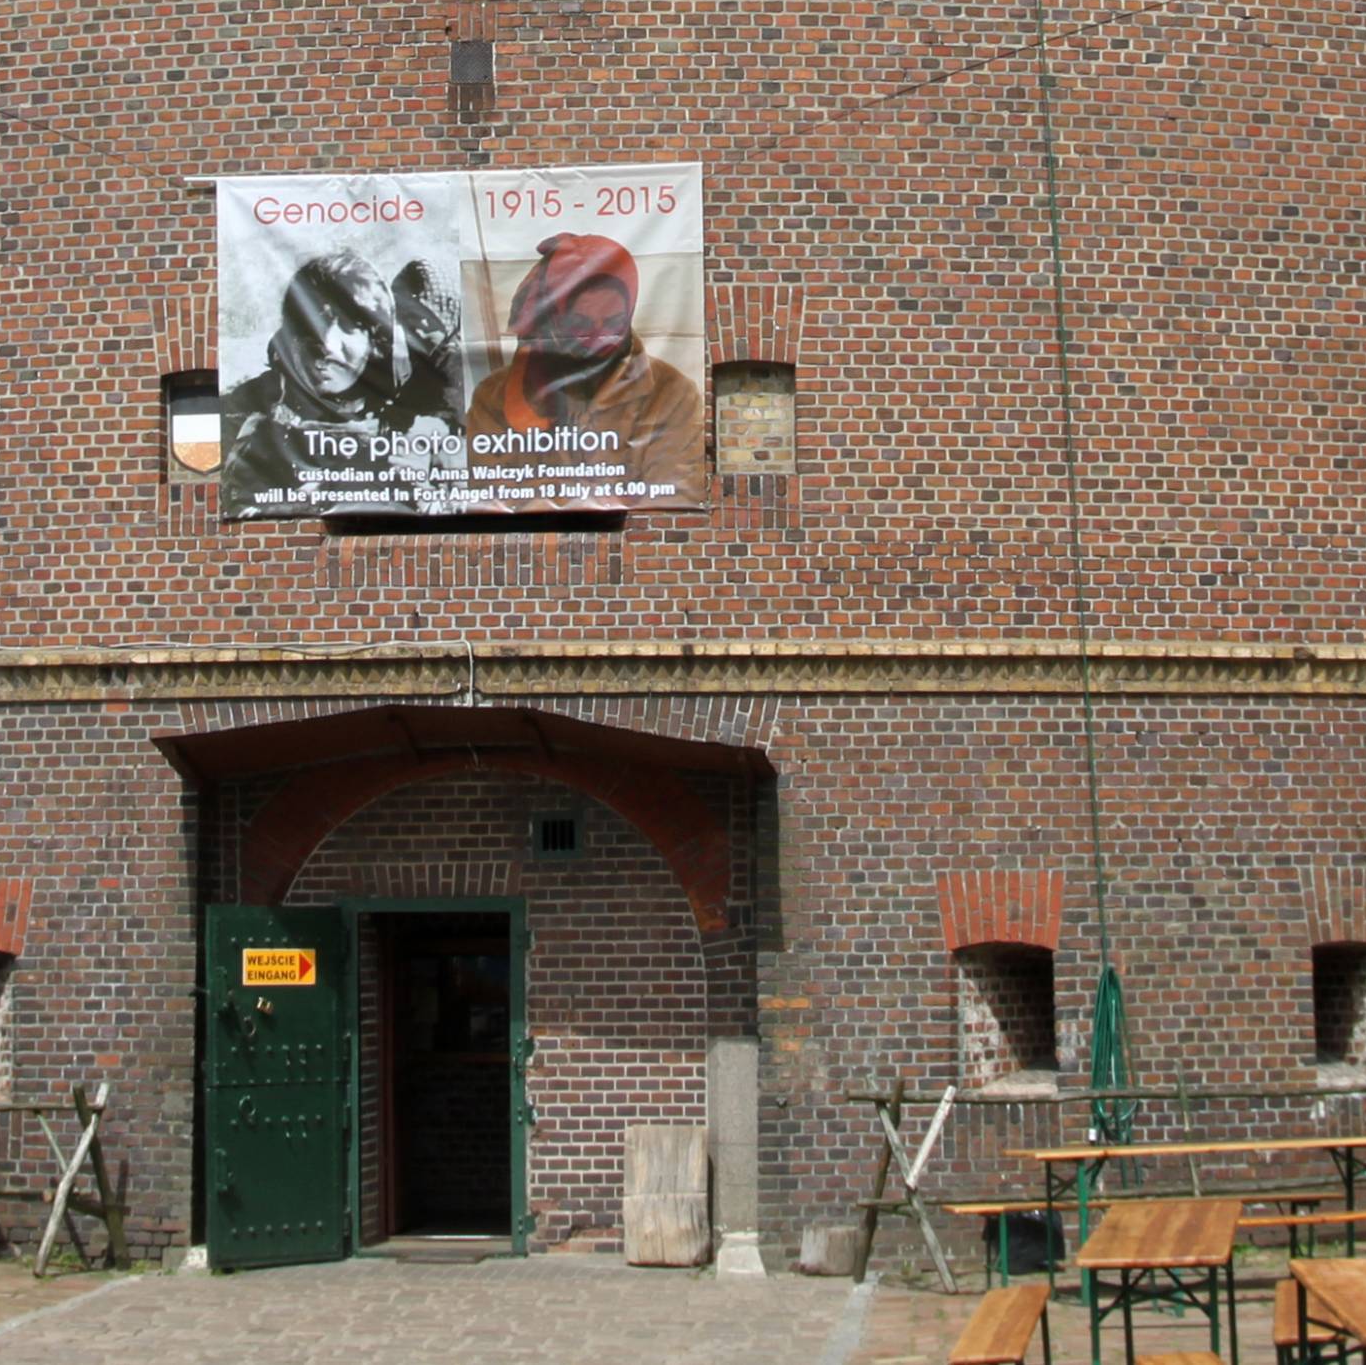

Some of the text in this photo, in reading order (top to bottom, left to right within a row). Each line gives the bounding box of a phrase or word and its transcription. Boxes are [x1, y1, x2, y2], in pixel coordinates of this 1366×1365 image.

[253, 195, 424, 224] Genocide
[485, 189, 562, 218] 1915
[596, 186, 676, 215] 2015
[303, 426, 619, 462] The photo exhibition
[298, 462, 626, 482] custodian of the Anna Walczyk Foundation
[254, 488, 283, 503] will
[287, 488, 307, 502] be
[310, 487, 390, 505] presented
[414, 488, 446, 501] Fort
[449, 485, 494, 503] Angel
[498, 485, 535, 500] from
[539, 484, 556, 498] 18
[559, 483, 590, 500] July
[594, 483, 611, 497] at
[614, 482, 646, 496] 6.00
[649, 483, 676, 498] pm
[247, 970, 297, 981] EINGANG
